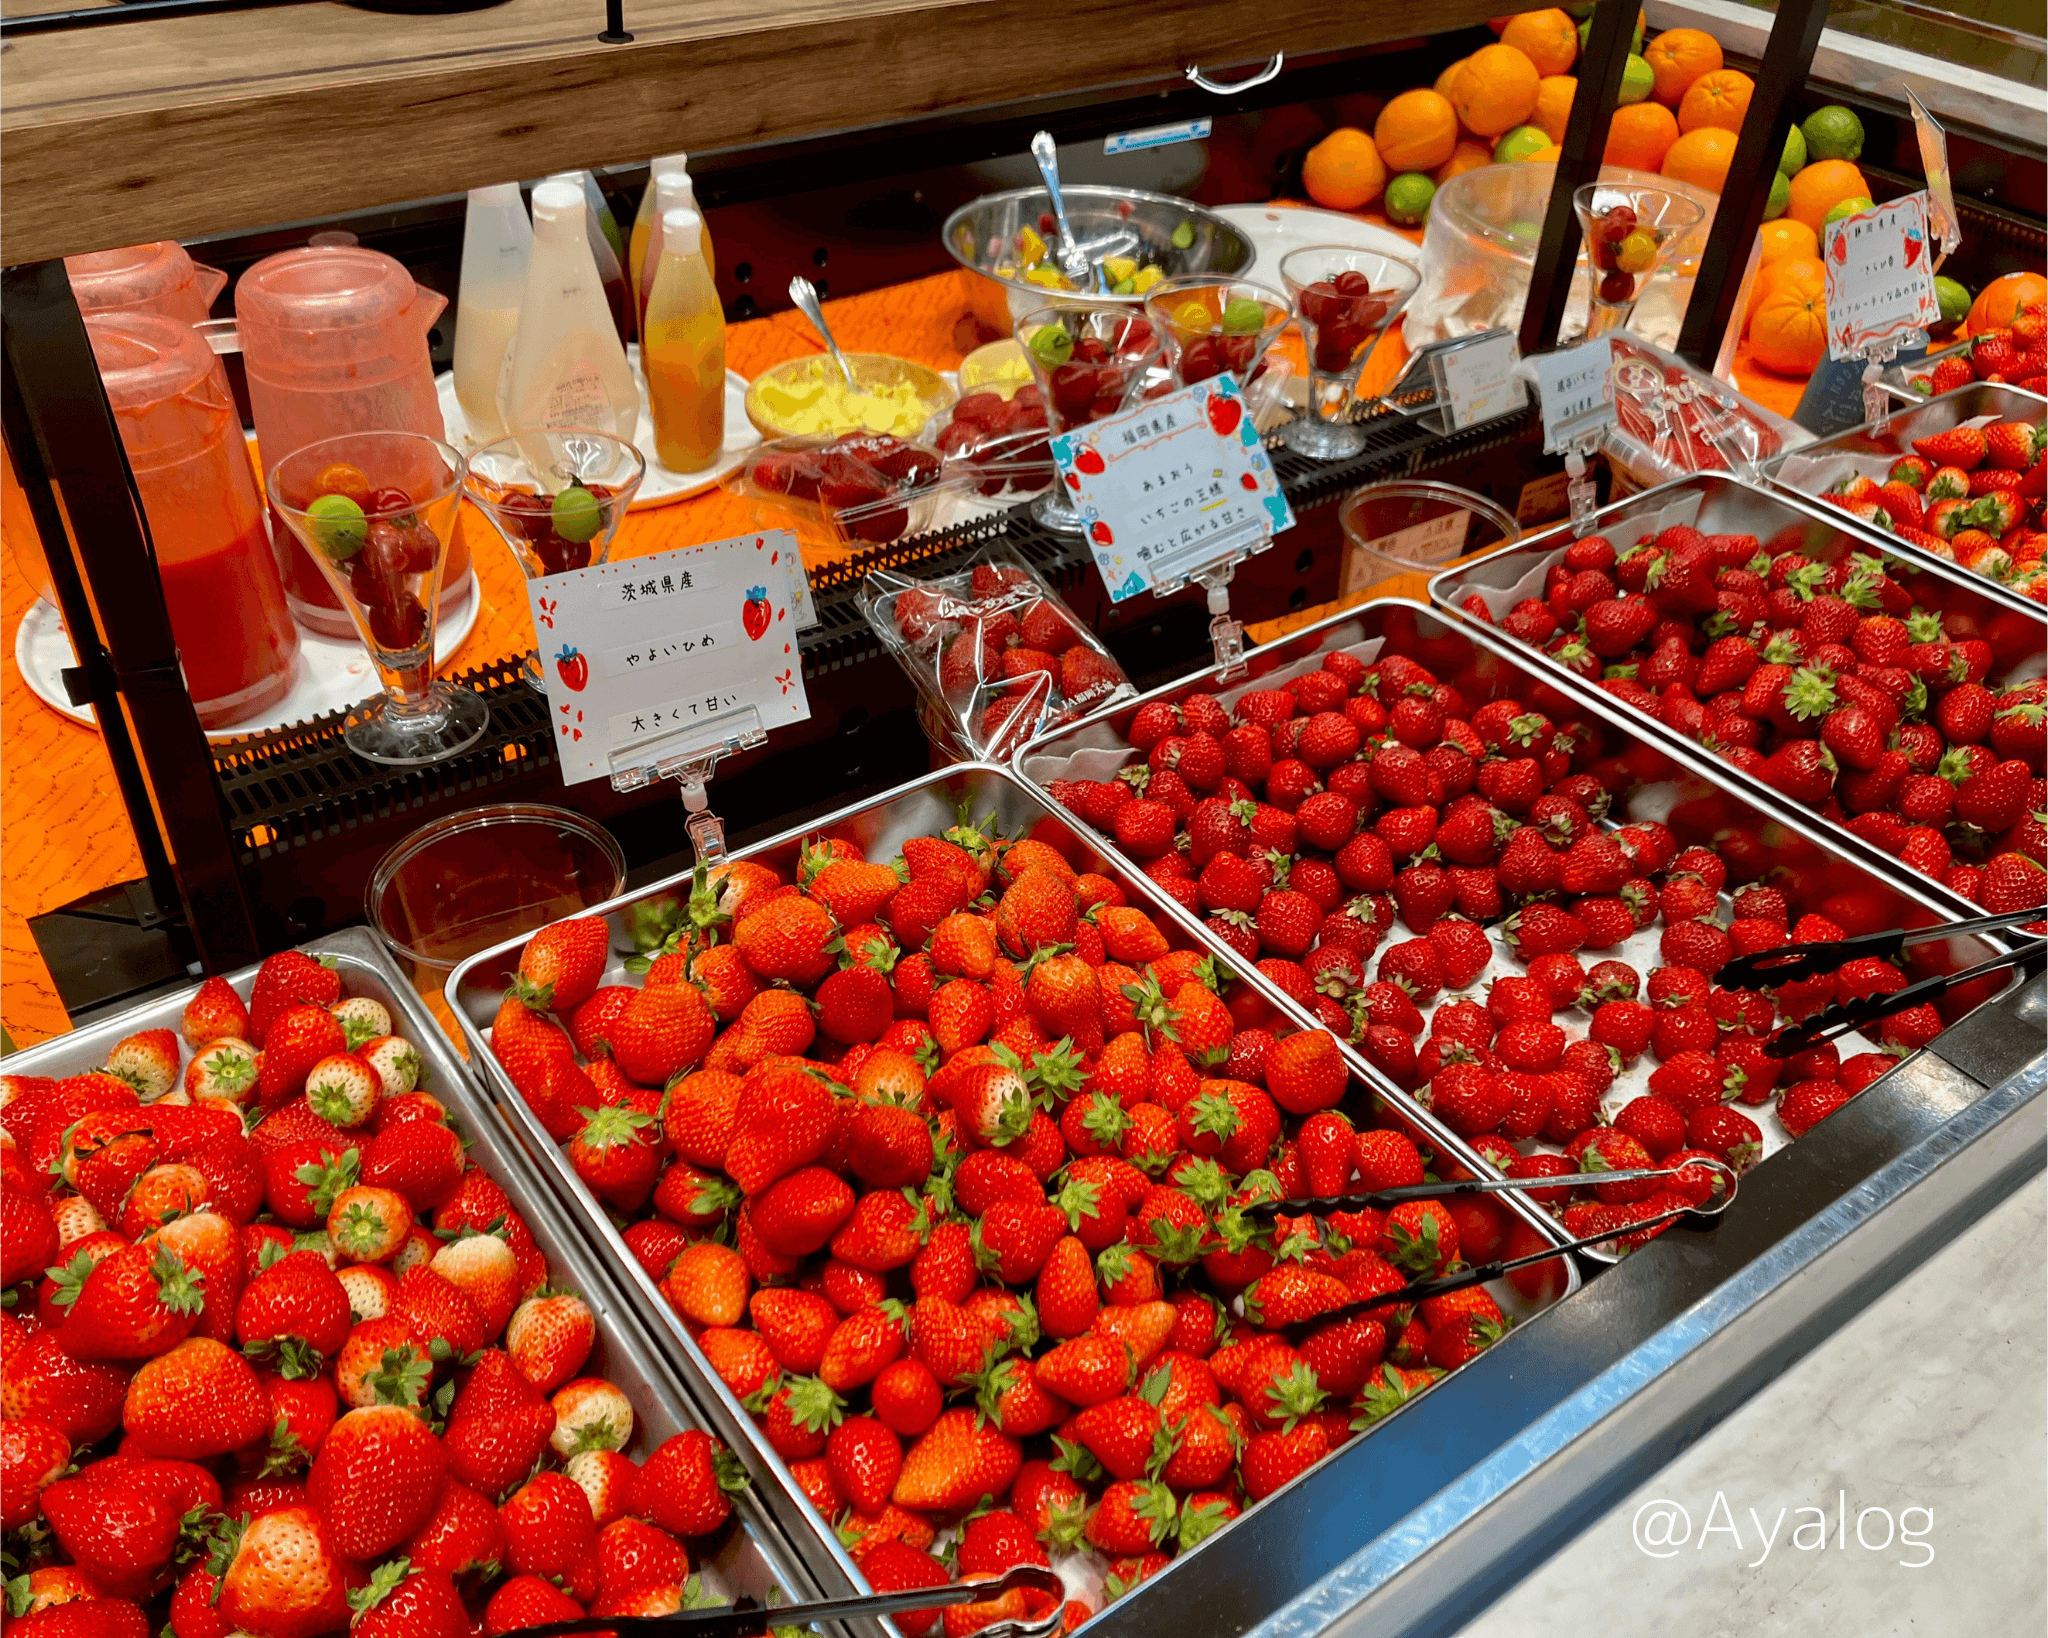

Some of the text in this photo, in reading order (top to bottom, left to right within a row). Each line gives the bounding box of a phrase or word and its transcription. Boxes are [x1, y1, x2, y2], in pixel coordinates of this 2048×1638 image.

[1121, 413, 1177, 445] 福岡県産
[1142, 462, 1194, 493] あまおう
[1140, 480, 1224, 525] いちごの王様
[1136, 507, 1246, 562] 噛むと広がる甘さ
[621, 570, 694, 602] 茨城県産
[626, 634, 715, 667] やよいひめ
[631, 694, 737, 733] 大きくて甘い
